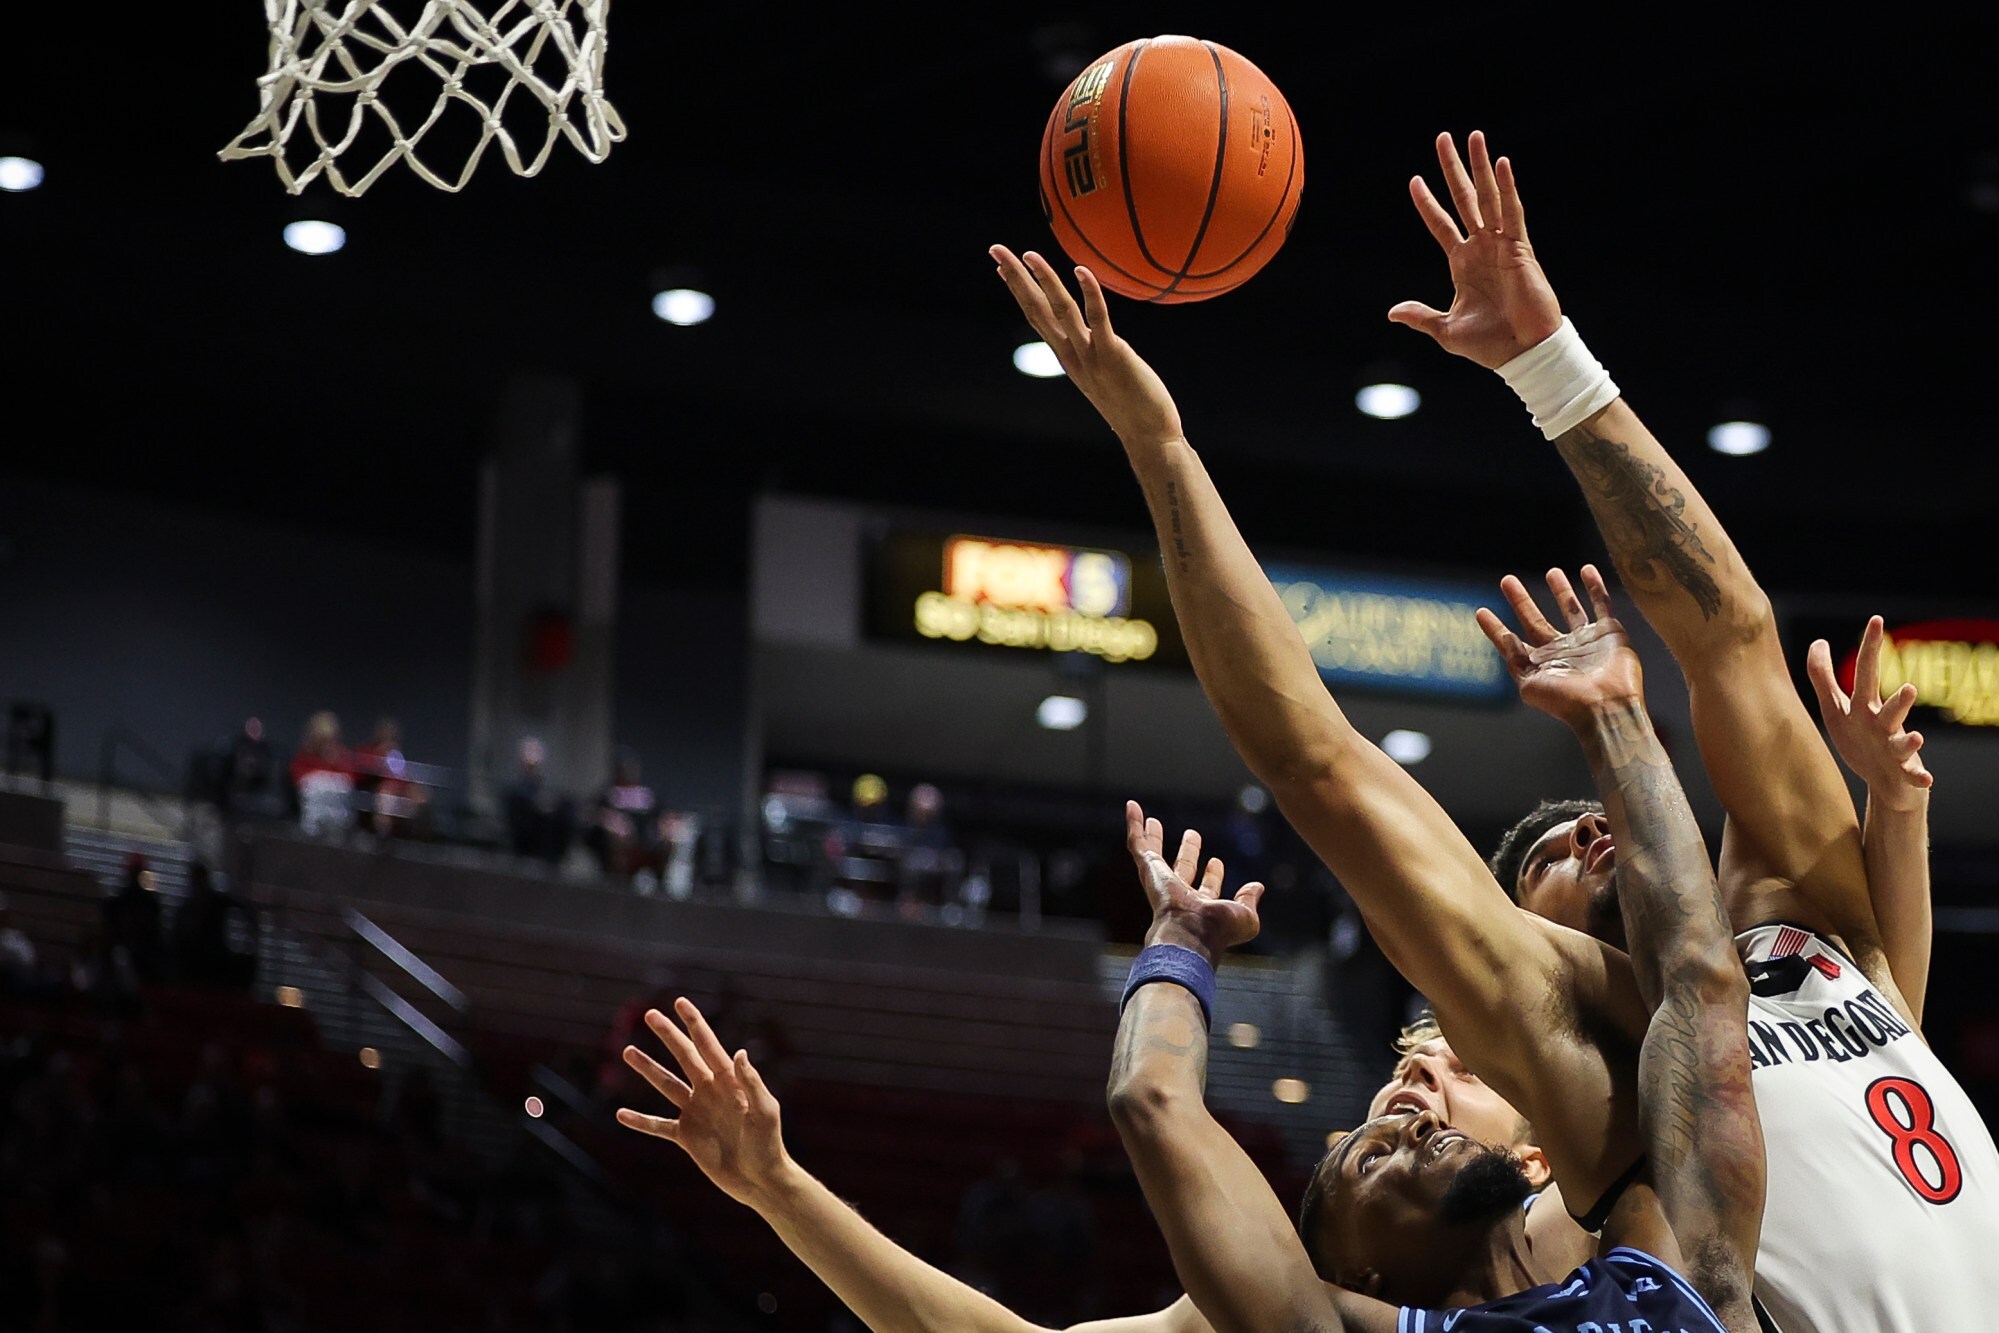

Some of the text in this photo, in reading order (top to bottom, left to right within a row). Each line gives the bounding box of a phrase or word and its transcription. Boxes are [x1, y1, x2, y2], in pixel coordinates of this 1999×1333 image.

[1748, 1020, 1793, 1070] AN
[1776, 1000, 1888, 1063] DEGO
[1864, 1075, 1963, 1205] 8
